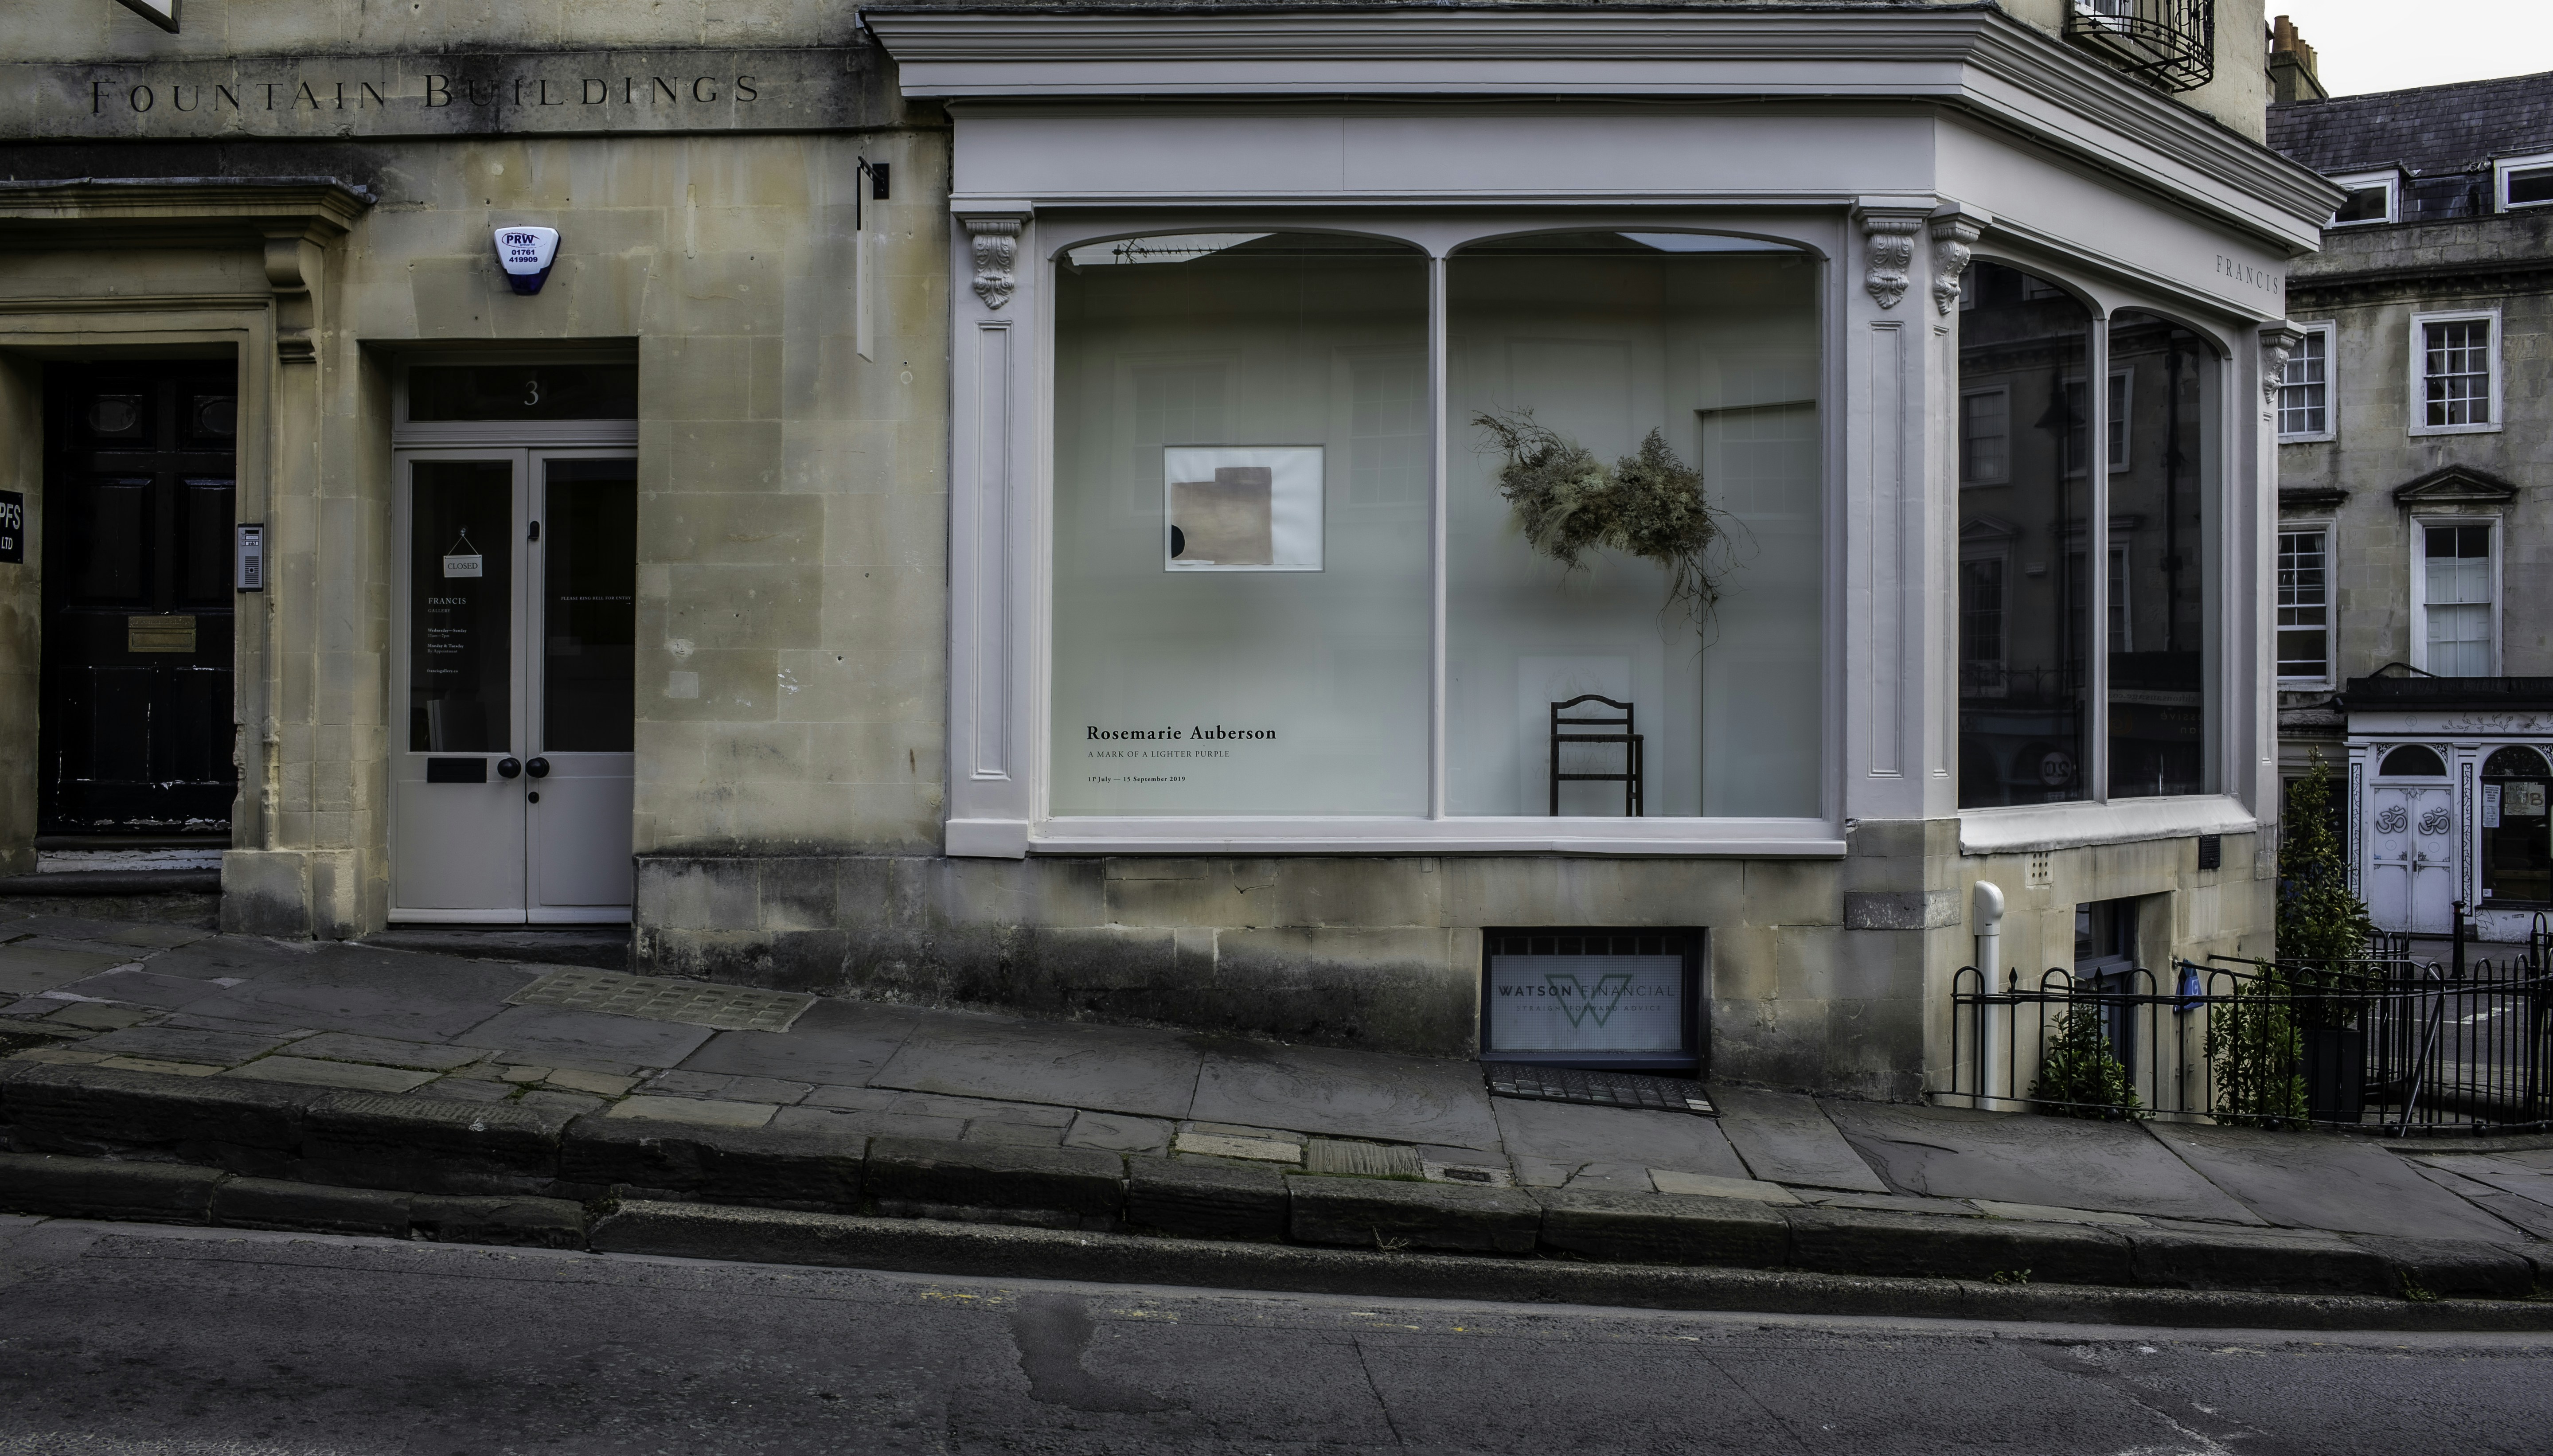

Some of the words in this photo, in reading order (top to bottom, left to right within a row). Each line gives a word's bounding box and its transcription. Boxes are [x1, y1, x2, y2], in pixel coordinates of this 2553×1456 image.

[91, 81, 386, 114] FOUNTAIN
[425, 74, 758, 108] BUILDINGS
[507, 234, 534, 244] PRW
[2217, 254, 2278, 294] FRANCIS
[524, 380, 539, 405] 3
[0, 502, 21, 530] PFS
[1, 536, 13, 550] LTD
[447, 562, 478, 570] CLOSED
[1086, 726, 1182, 740] Rosemarie
[1190, 725, 1276, 740] Auberson
[1499, 985, 1572, 996] WATSON
[1581, 985, 1675, 996] FINANCIAL
